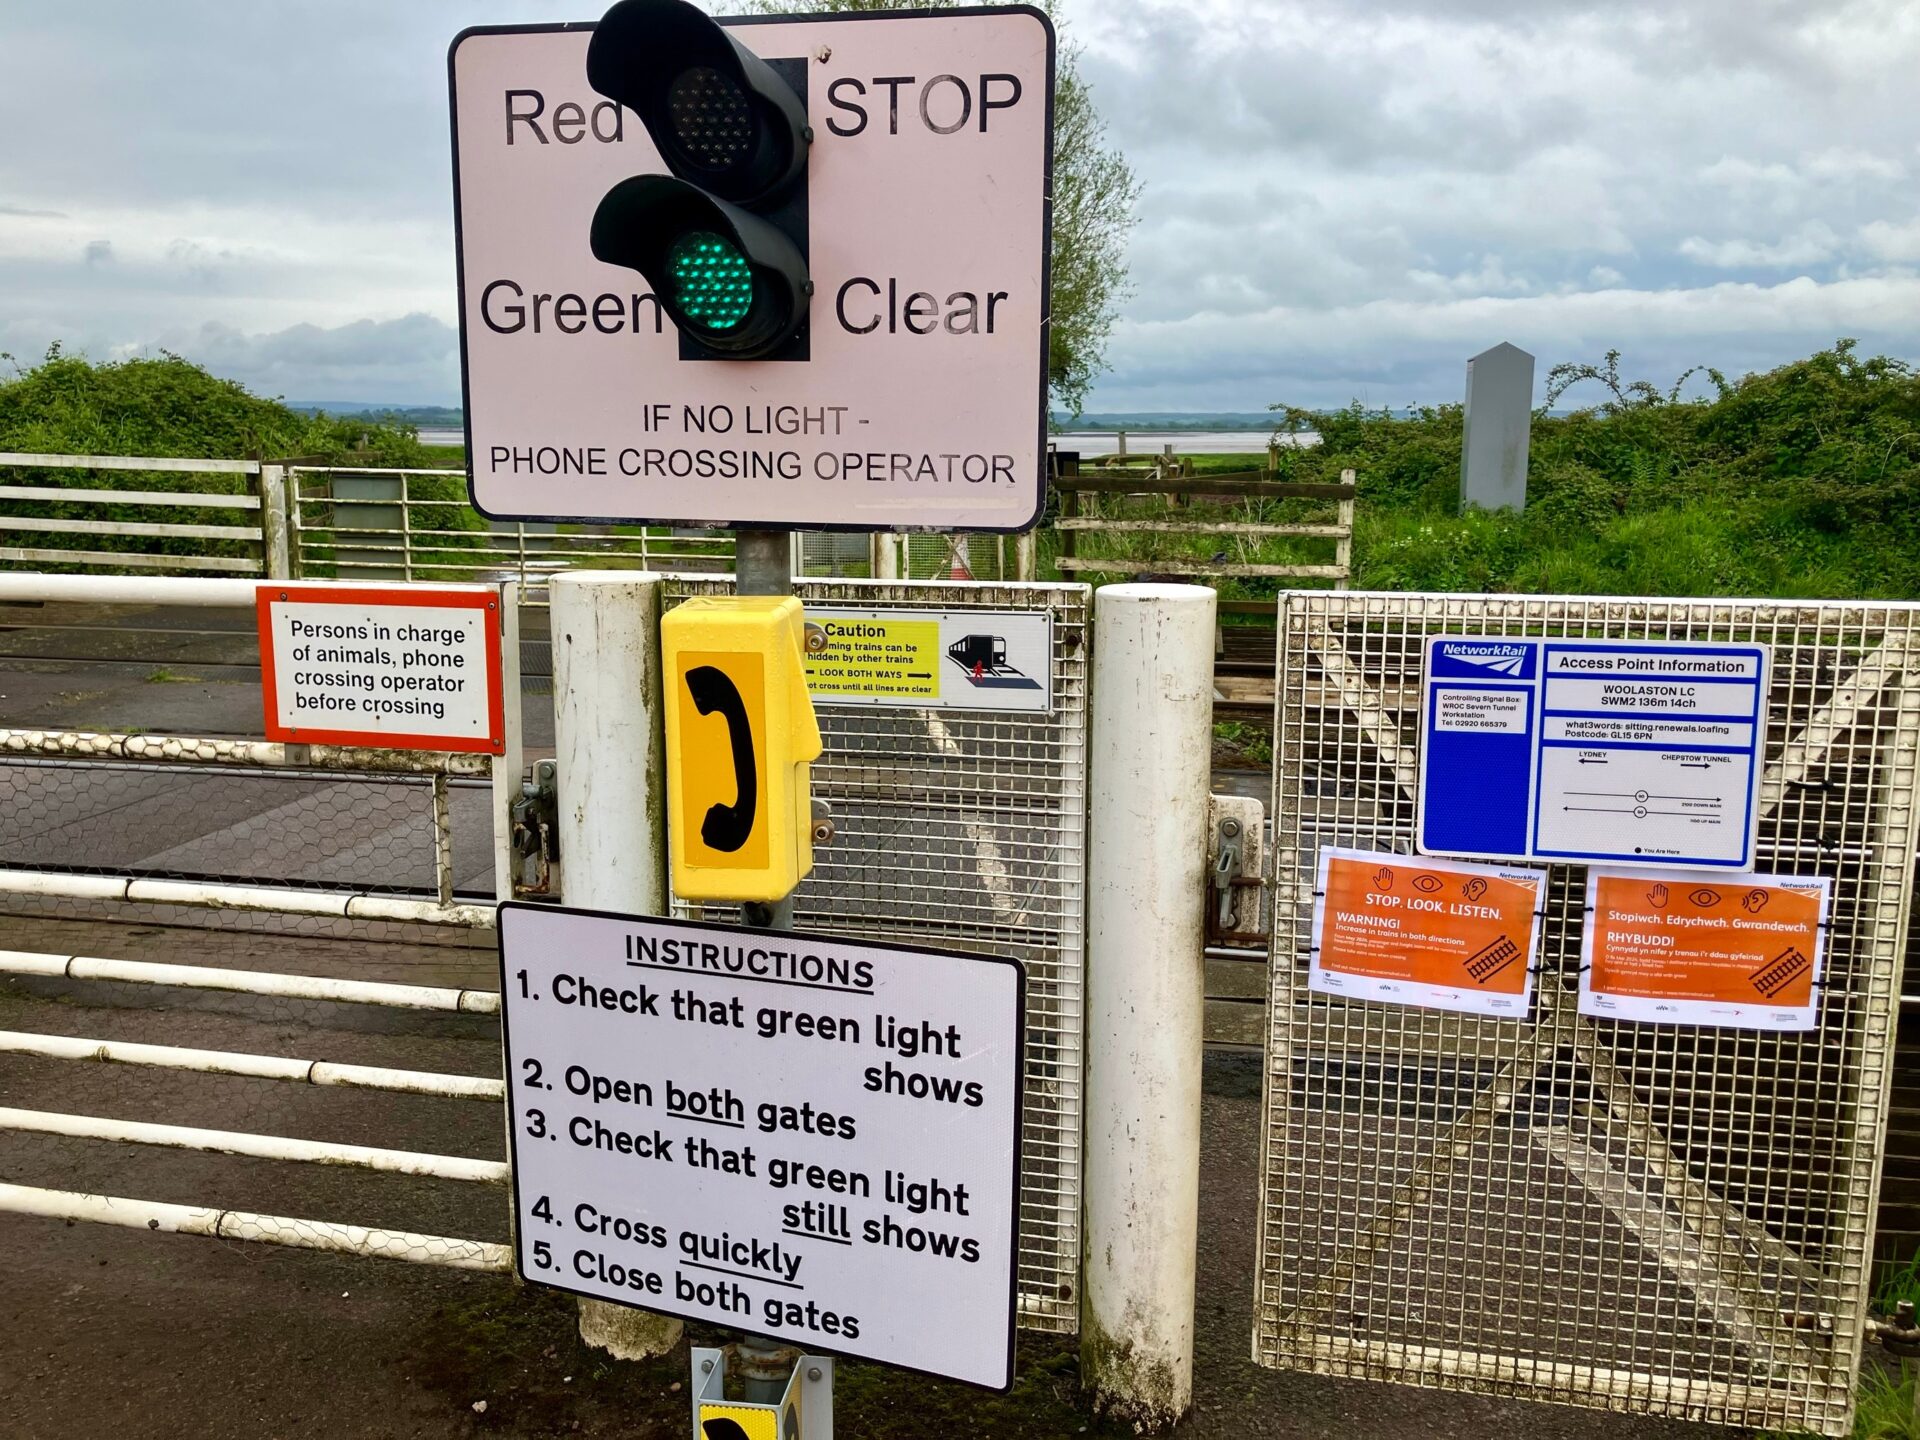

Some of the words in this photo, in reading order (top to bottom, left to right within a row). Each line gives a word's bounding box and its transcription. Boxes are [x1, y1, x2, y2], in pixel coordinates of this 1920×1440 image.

[505, 90, 624, 146] Red
[825, 73, 1023, 137] STOP
[481, 279, 662, 335] Green
[835, 277, 1009, 336] Clear
[643, 404, 671, 433] IF
[683, 406, 734, 434] NO
[746, 406, 849, 435] LIGHT
[491, 447, 607, 476] PHONE
[618, 448, 802, 480] CROSSING
[814, 452, 1016, 485] OPERATOR
[291, 620, 368, 639] Persons
[374, 623, 390, 640] in
[397, 625, 465, 646] charge
[824, 623, 886, 637] Caution
[293, 645, 311, 661] of
[316, 646, 397, 669] animals,
[403, 649, 465, 669] phone
[855, 643, 882, 651] trains
[905, 644, 918, 652] be
[1443, 644, 1527, 656] NetworkRail
[807, 653, 839, 661] hidden
[842, 654, 854, 663] by
[857, 654, 882, 663] other
[886, 655, 914, 664] trains
[1559, 657, 1613, 669] Access
[1617, 658, 1655, 671] Point
[1658, 659, 1745, 673] Information
[294, 671, 375, 691] crossing
[381, 675, 465, 692] operator
[819, 669, 844, 677] LOOK
[847, 670, 872, 678] BOTH
[875, 671, 902, 679] WAYS
[842, 682, 861, 690] until
[875, 684, 895, 692] lines
[911, 685, 931, 693] clear
[1603, 685, 1678, 696] WOOLASTON
[1680, 686, 1695, 696] LC
[296, 692, 356, 711] before
[363, 696, 444, 719] crossing
[1442, 694, 1481, 702] Controlling
[1482, 695, 1504, 703] Signal
[1466, 703, 1491, 711] Severn
[1601, 696, 1636, 706] SWM2
[1639, 697, 1667, 707] 136m
[1671, 698, 1696, 708] 14ch
[1565, 730, 1609, 738] Postcode:
[1610, 731, 1632, 739] GL15
[1634, 732, 1653, 740] 6PN
[1566, 721, 1623, 730] what3words:
[1661, 754, 1701, 762] CHEPSTOW
[1499, 872, 1540, 881] NetworkRail
[1366, 893, 1403, 909] STOP.
[1407, 898, 1446, 913] LOOK.
[1450, 903, 1503, 920] LISTEN.
[1336, 912, 1401, 930] WARNING!
[1608, 910, 1663, 925] Stopiwch.
[1666, 915, 1729, 929] Edrychwch.
[1732, 918, 1810, 933] Gwrandewch.
[1335, 923, 1367, 934] Increase
[1368, 927, 1376, 935] in
[1377, 928, 1399, 937] trains
[1409, 932, 1426, 941] both
[1428, 934, 1465, 946] directions
[1607, 932, 1675, 947] RHYBUDD!
[625, 934, 874, 988] INSTRUCTIONS
[1606, 944, 1638, 954] Cynnydd
[1710, 951, 1728, 959] ddau
[1730, 952, 1764, 961] gyfeiriad
[517, 969, 540, 1000] 1.
[551, 973, 660, 1017] Check
[671, 990, 745, 1029] that
[757, 1004, 860, 1045] green
[875, 1015, 962, 1058] light
[863, 1061, 984, 1108] shows
[522, 1058, 553, 1091] 2.
[565, 1063, 653, 1107] Open
[666, 1080, 745, 1122] both
[757, 1102, 857, 1140] gates
[525, 1108, 557, 1142] 3.
[569, 1116, 673, 1162] Check
[685, 1136, 757, 1177] that
[768, 1158, 870, 1198] green
[884, 1169, 970, 1216] light
[531, 1195, 563, 1227] 4.
[574, 1202, 668, 1248] Cross
[679, 1230, 803, 1282] quickly
[783, 1201, 849, 1238] still
[862, 1215, 981, 1264] shows
[532, 1240, 562, 1273] 5.
[573, 1249, 663, 1295] Close
[675, 1271, 751, 1315] both
[764, 1297, 860, 1339] gates
